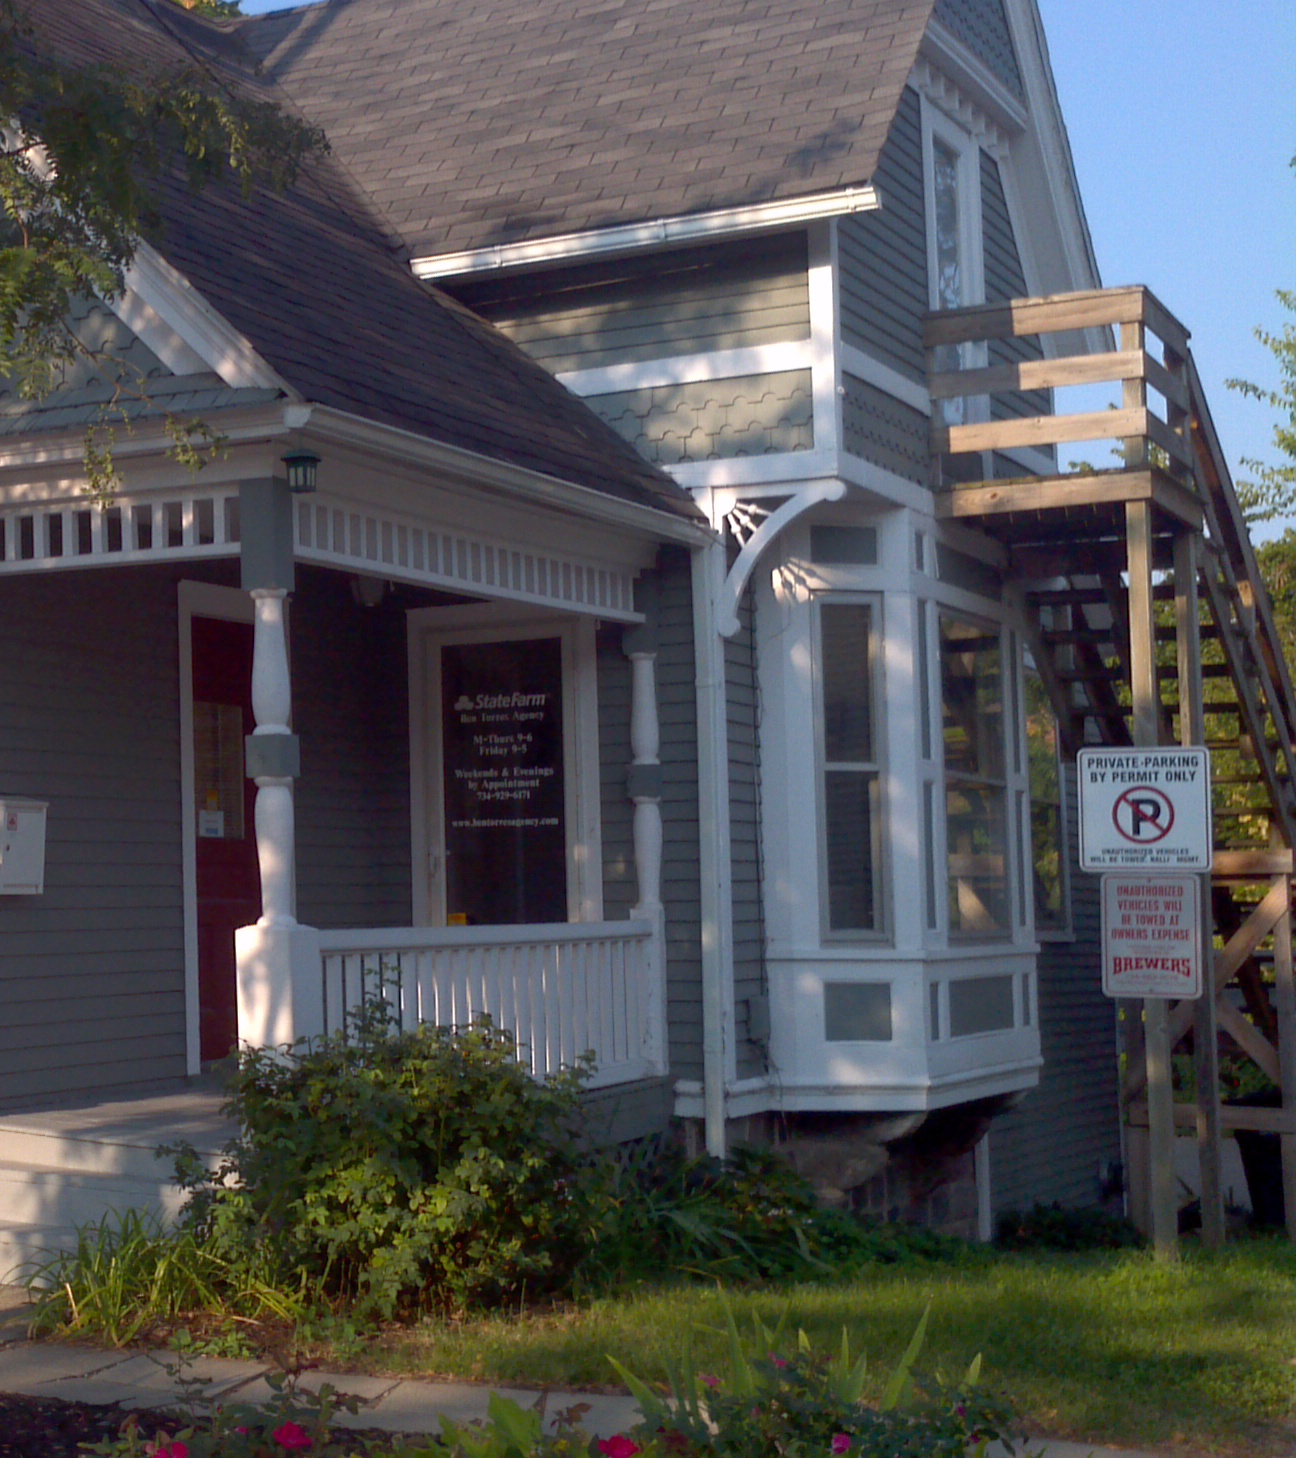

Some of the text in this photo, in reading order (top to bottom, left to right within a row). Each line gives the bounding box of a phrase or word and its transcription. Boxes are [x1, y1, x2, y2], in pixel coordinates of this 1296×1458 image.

[475, 691, 546, 709] StateFarm
[512, 711, 544, 721] Agency
[517, 733, 533, 742] 9-6
[479, 746, 508, 756] Friday
[1087, 755, 1199, 769] PRIVATE PARKING
[455, 766, 554, 778] Weekends & Evenings
[1090, 770, 1196, 783] BY PERMIT ONLY
[468, 779, 540, 791] by Appointment
[1117, 885, 1183, 897] UNAUTHORIZED
[1117, 899, 1182, 912] VEHICLES WILL
[1121, 914, 1179, 926] BE TOWED AT
[1111, 928, 1190, 941] OWNERS EXPENSE
[1113, 956, 1190, 978] BREWERS
